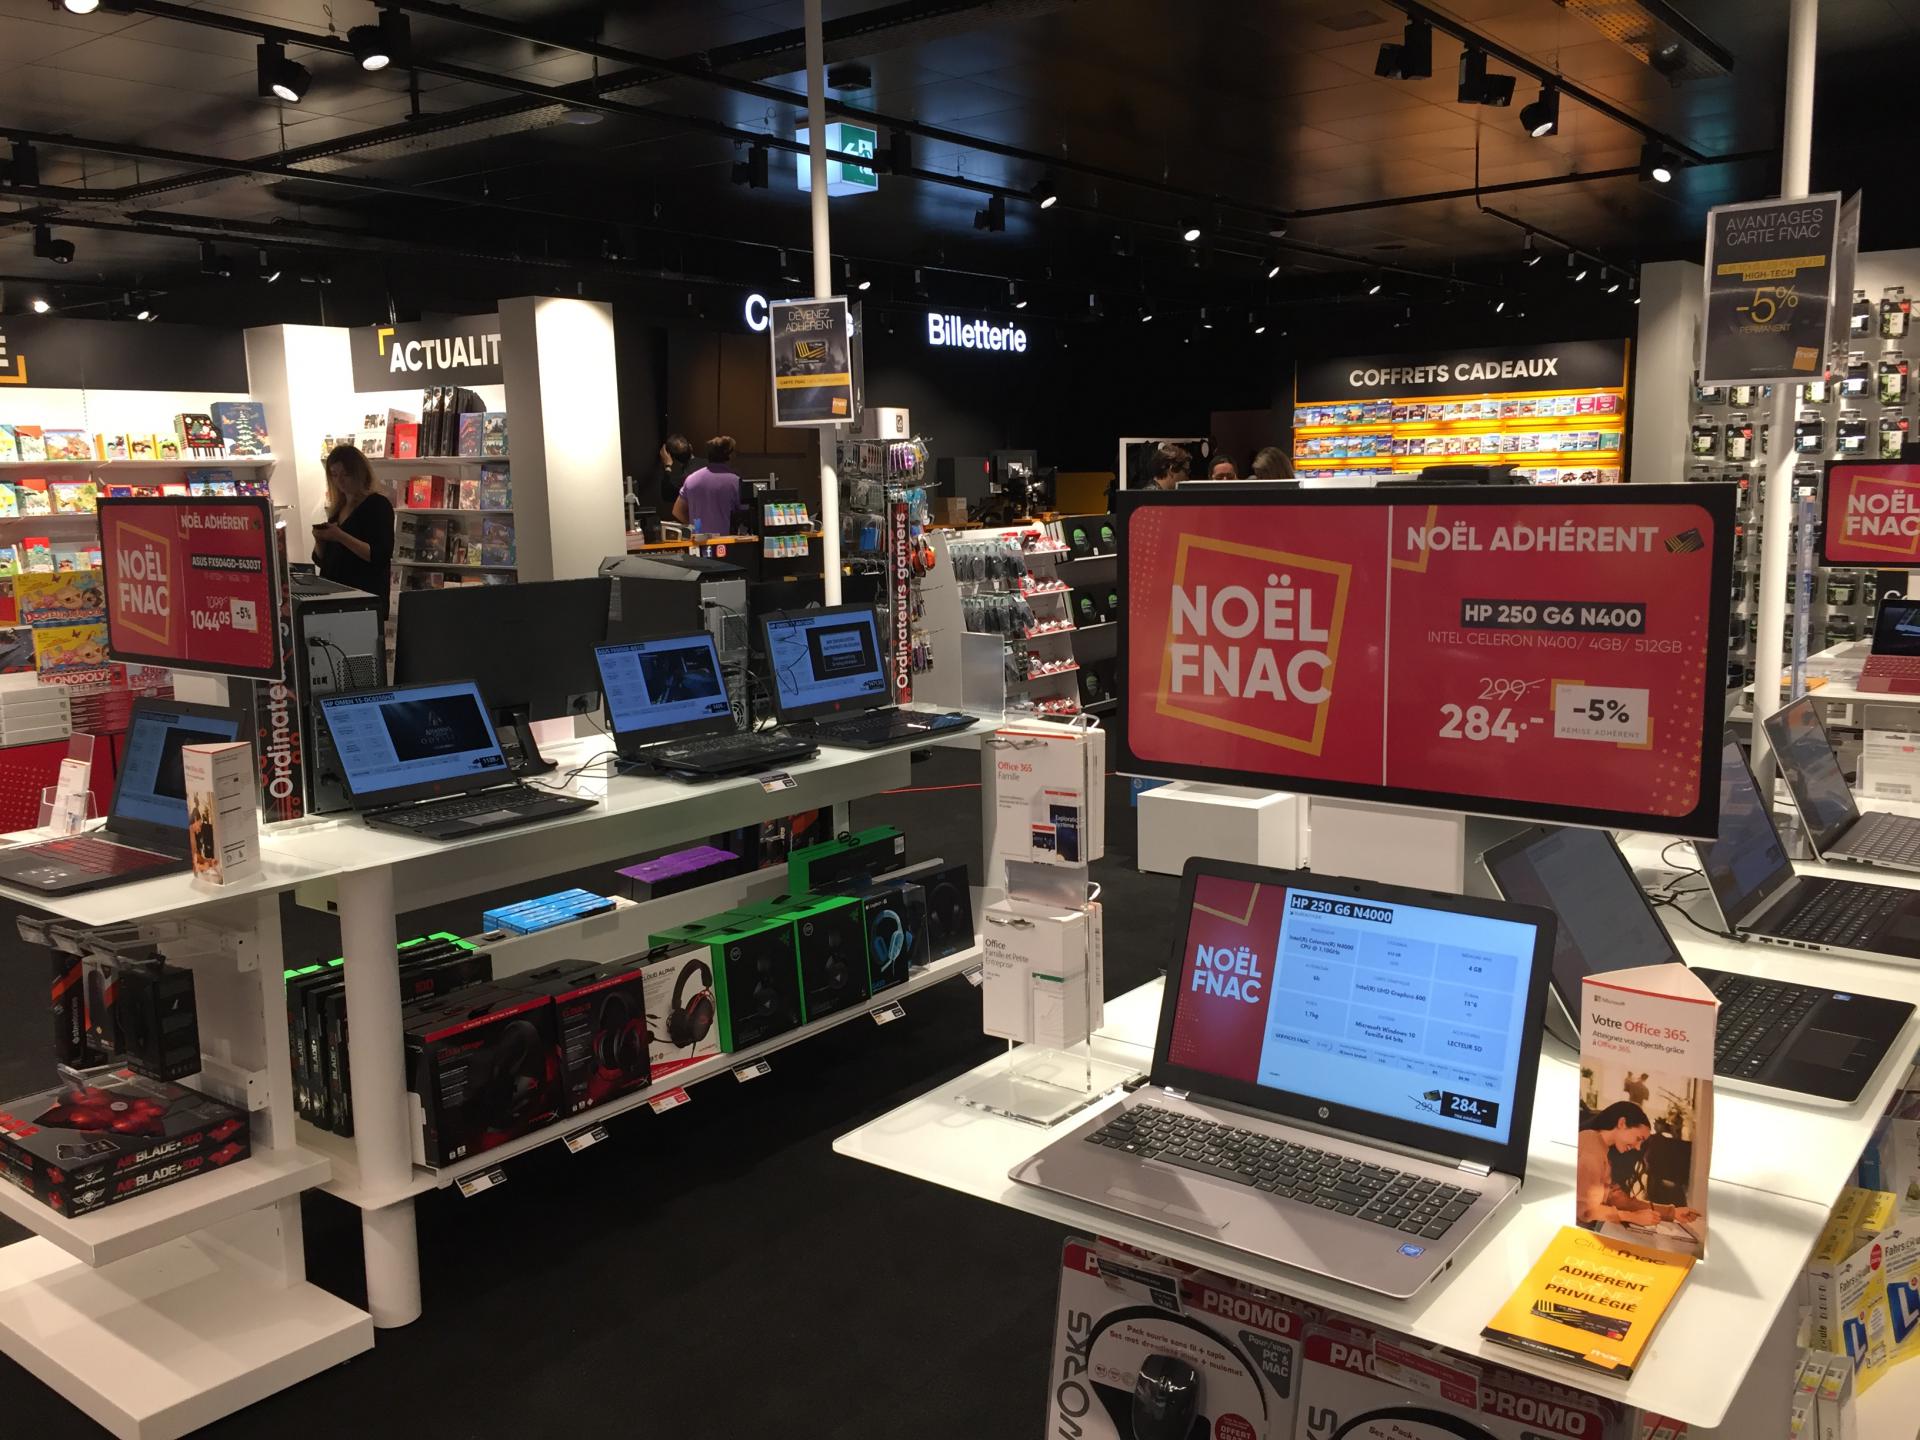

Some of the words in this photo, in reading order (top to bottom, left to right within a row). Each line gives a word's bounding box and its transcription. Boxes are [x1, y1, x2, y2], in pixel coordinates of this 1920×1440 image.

[1726, 208, 1824, 231] AVANTAGES
[1727, 229, 1775, 246] CARTE
[1779, 224, 1821, 240] FNAC
[1744, 268, 1795, 280] HIGH-TECH
[788, 308, 831, 322] DEVENEZ
[1736, 285, 1798, 323] -5%
[928, 312, 1027, 352] Billetterie
[1350, 365, 1449, 387] COFFRETS
[1455, 358, 1558, 381] CADEAUX
[1848, 489, 1920, 514] NOËL
[181, 512, 203, 528] NOËL
[205, 514, 249, 532] ADHÉRENT
[1847, 515, 1920, 536] FNAC
[896, 512, 909, 581] gamers
[1406, 520, 1483, 551] NOËL
[1490, 519, 1660, 552] ADHÉRENT
[117, 544, 167, 582] NOËL
[192, 556, 208, 567] ASUS
[119, 583, 170, 616] FNAC
[1171, 573, 1329, 643] NOËL
[1464, 604, 1493, 622] HP
[1497, 605, 1537, 624] 250
[1542, 606, 1574, 625] G6
[1581, 607, 1642, 628] N400
[896, 585, 909, 689] Ordinateurs
[1427, 631, 1463, 645] INTEL
[1466, 632, 1533, 648] CELERON
[1634, 638, 1682, 654] 512GB
[1170, 642, 1333, 705] FNAC
[1439, 702, 1544, 743] 284.-
[1572, 698, 1630, 724] -5%
[266, 660, 294, 799] Ordinate
[1561, 727, 1592, 736] REMISE
[997, 761, 1018, 772] Office
[1019, 763, 1033, 773] 365
[998, 771, 1020, 781] Famille
[1291, 897, 1308, 908] HP
[1311, 900, 1332, 912] 250
[1334, 904, 1351, 916] G6
[1353, 907, 1392, 922] N4000
[985, 938, 1006, 950] Office
[658, 966, 676, 977] ALPHA
[985, 957, 1014, 968] Entreprise
[1195, 943, 1262, 979] NOËL
[1191, 969, 1263, 1004] FNAC
[1592, 1013, 1622, 1030] Votre
[1624, 1020, 1660, 1037] Office
[1663, 1027, 1691, 1042] 365.
[1447, 1039, 1473, 1050] LECTEUR
[1473, 1044, 1483, 1052] SD
[1592, 1030, 1624, 1044] Atteignez
[1624, 1037, 1636, 1045] vos
[1636, 1039, 1665, 1053] objectifs
[1665, 1045, 1685, 1056] grâce
[1597, 1040, 1618, 1051] Office
[1415, 1100, 1439, 1113] 299.-
[1450, 1096, 1488, 1115] 284.-
[1564, 1255, 1655, 1283] DEVENEZ
[1614, 1249, 1667, 1266] fnac
[1559, 1264, 1648, 1292] ADHÉRENT
[1544, 1283, 1638, 1313] PRIVILÉGIÉ
[1203, 1289, 1291, 1333] PROMO
[1109, 1330, 1123, 1342] Set
[1124, 1334, 1140, 1346] met
[1126, 1324, 1145, 1337] Pack
[1146, 1329, 1169, 1343] souris
[1170, 1338, 1189, 1350] sans
[1189, 1342, 1199, 1351] fil
[1206, 1349, 1227, 1363] tapis
[1247, 1334, 1290, 1355] Pour/voor
[1262, 1348, 1277, 1363] PC
[1281, 1356, 1290, 1366] &
[1590, 1348, 1623, 1363] fnac
[1261, 1360, 1290, 1378] MAC
[1477, 1388, 1587, 1434] PROMO
[1220, 1426, 1251, 1439] OFFERT
